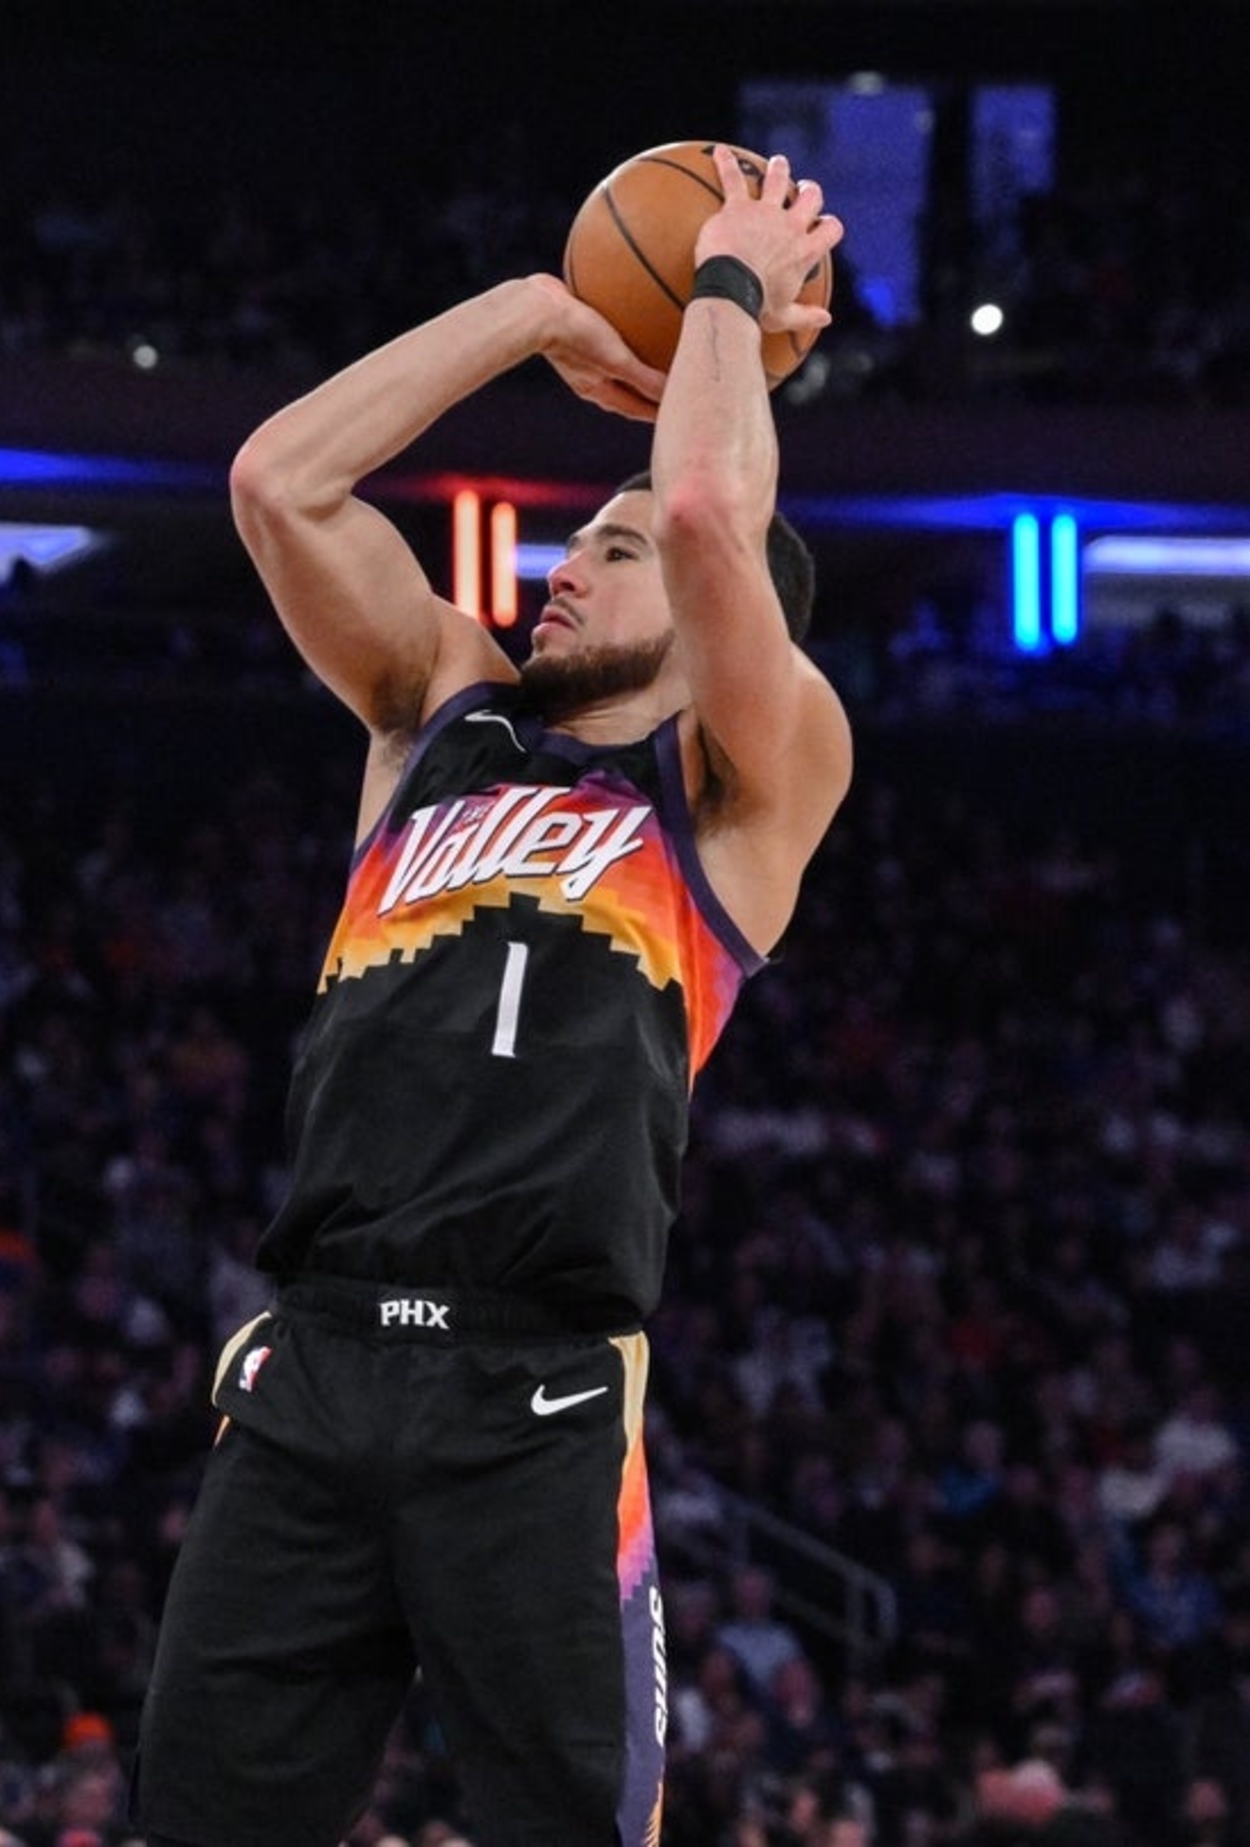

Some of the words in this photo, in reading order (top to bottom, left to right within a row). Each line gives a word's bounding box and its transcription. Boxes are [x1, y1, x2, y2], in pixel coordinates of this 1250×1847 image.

[378, 786, 651, 915] Valley
[491, 941, 528, 1058] 1
[379, 1299, 450, 1330] PHX
